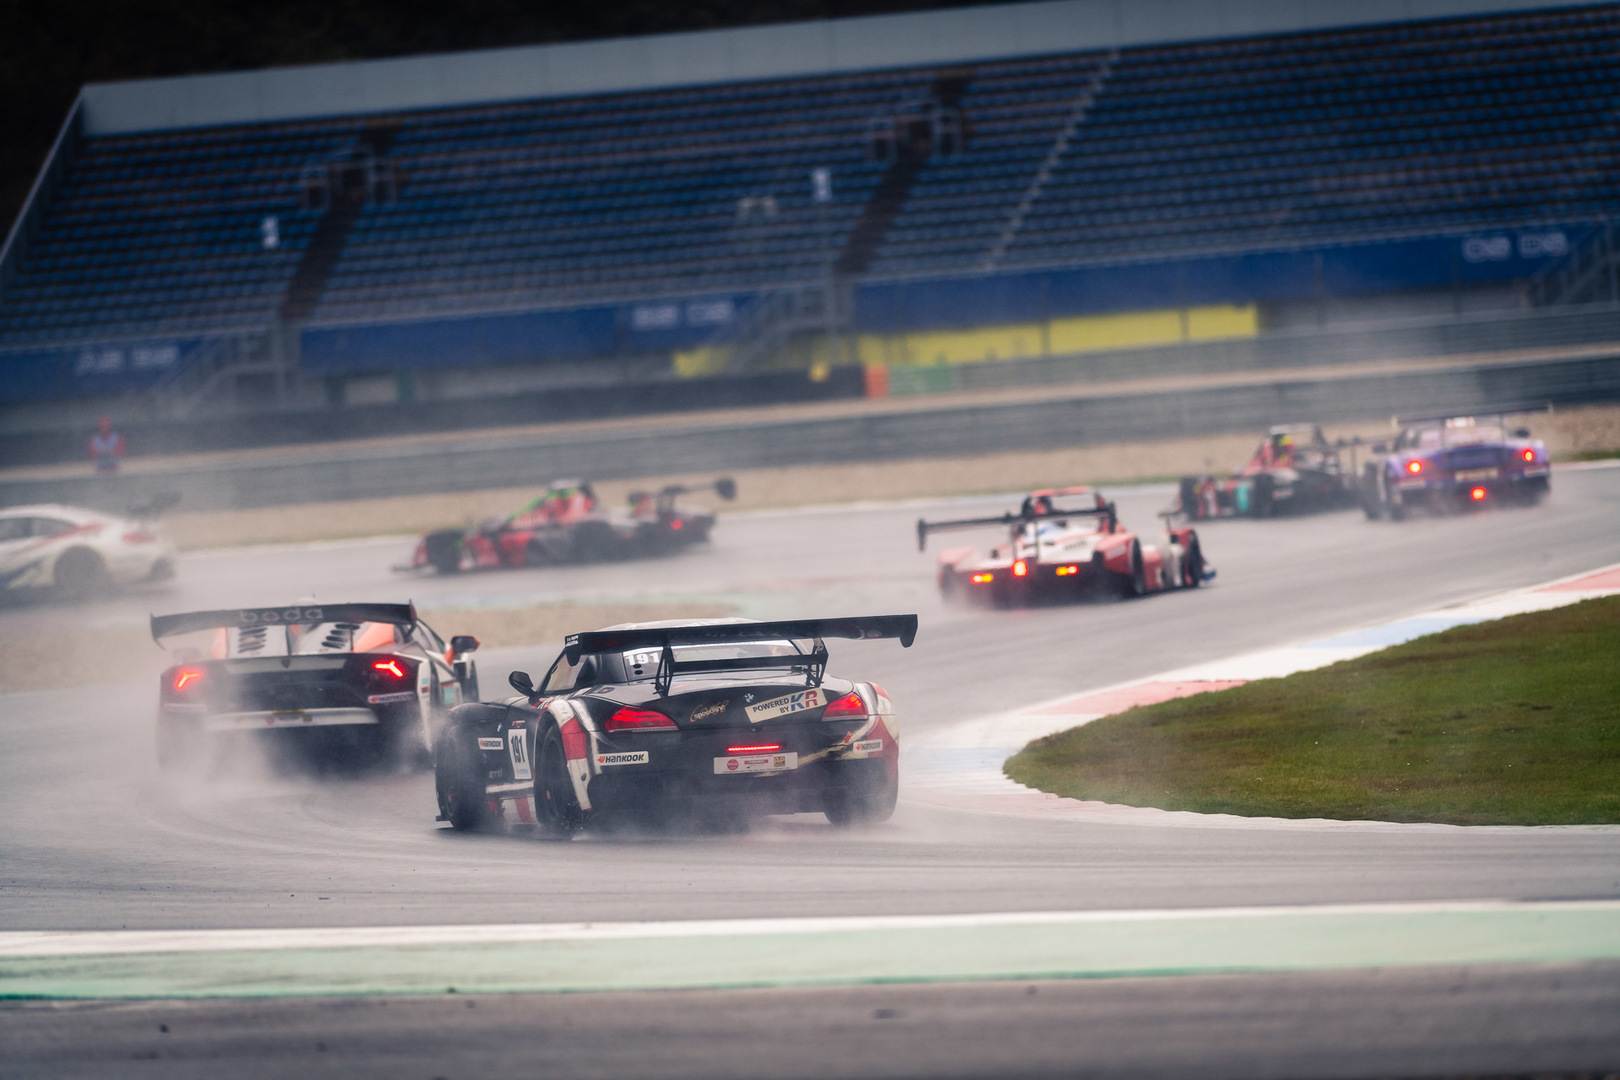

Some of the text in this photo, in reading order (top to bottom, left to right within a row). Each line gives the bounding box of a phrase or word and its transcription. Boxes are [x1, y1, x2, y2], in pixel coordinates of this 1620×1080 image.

[625, 652, 660, 666] 191
[753, 697, 790, 713] POWERED
[791, 690, 818, 711] KR
[780, 705, 790, 714] BY
[511, 735, 525, 764] 191
